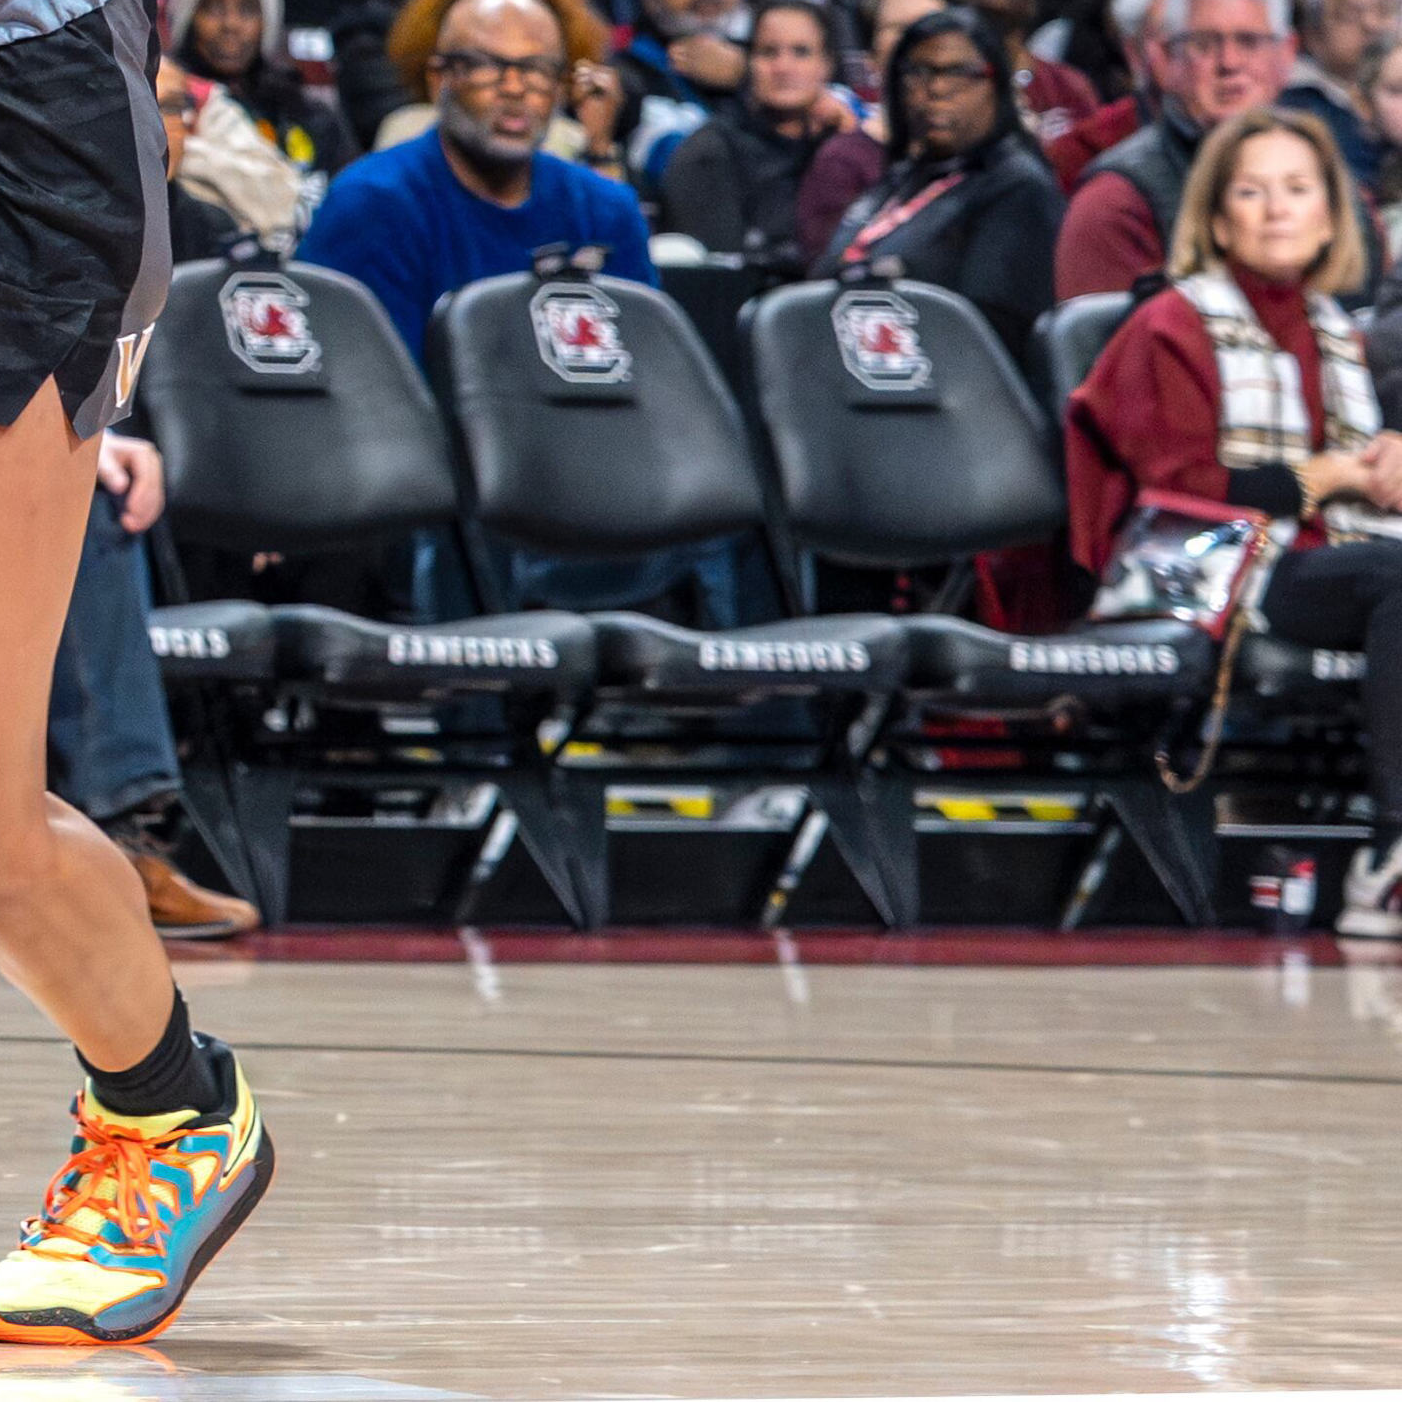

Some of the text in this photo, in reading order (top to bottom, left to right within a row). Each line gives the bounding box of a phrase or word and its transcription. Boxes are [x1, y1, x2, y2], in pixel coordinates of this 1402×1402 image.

[387, 633, 559, 669] GAMECOCKS
[698, 641, 871, 672] GAMECOCKS
[1009, 641, 1180, 674] GAMECOCKS
